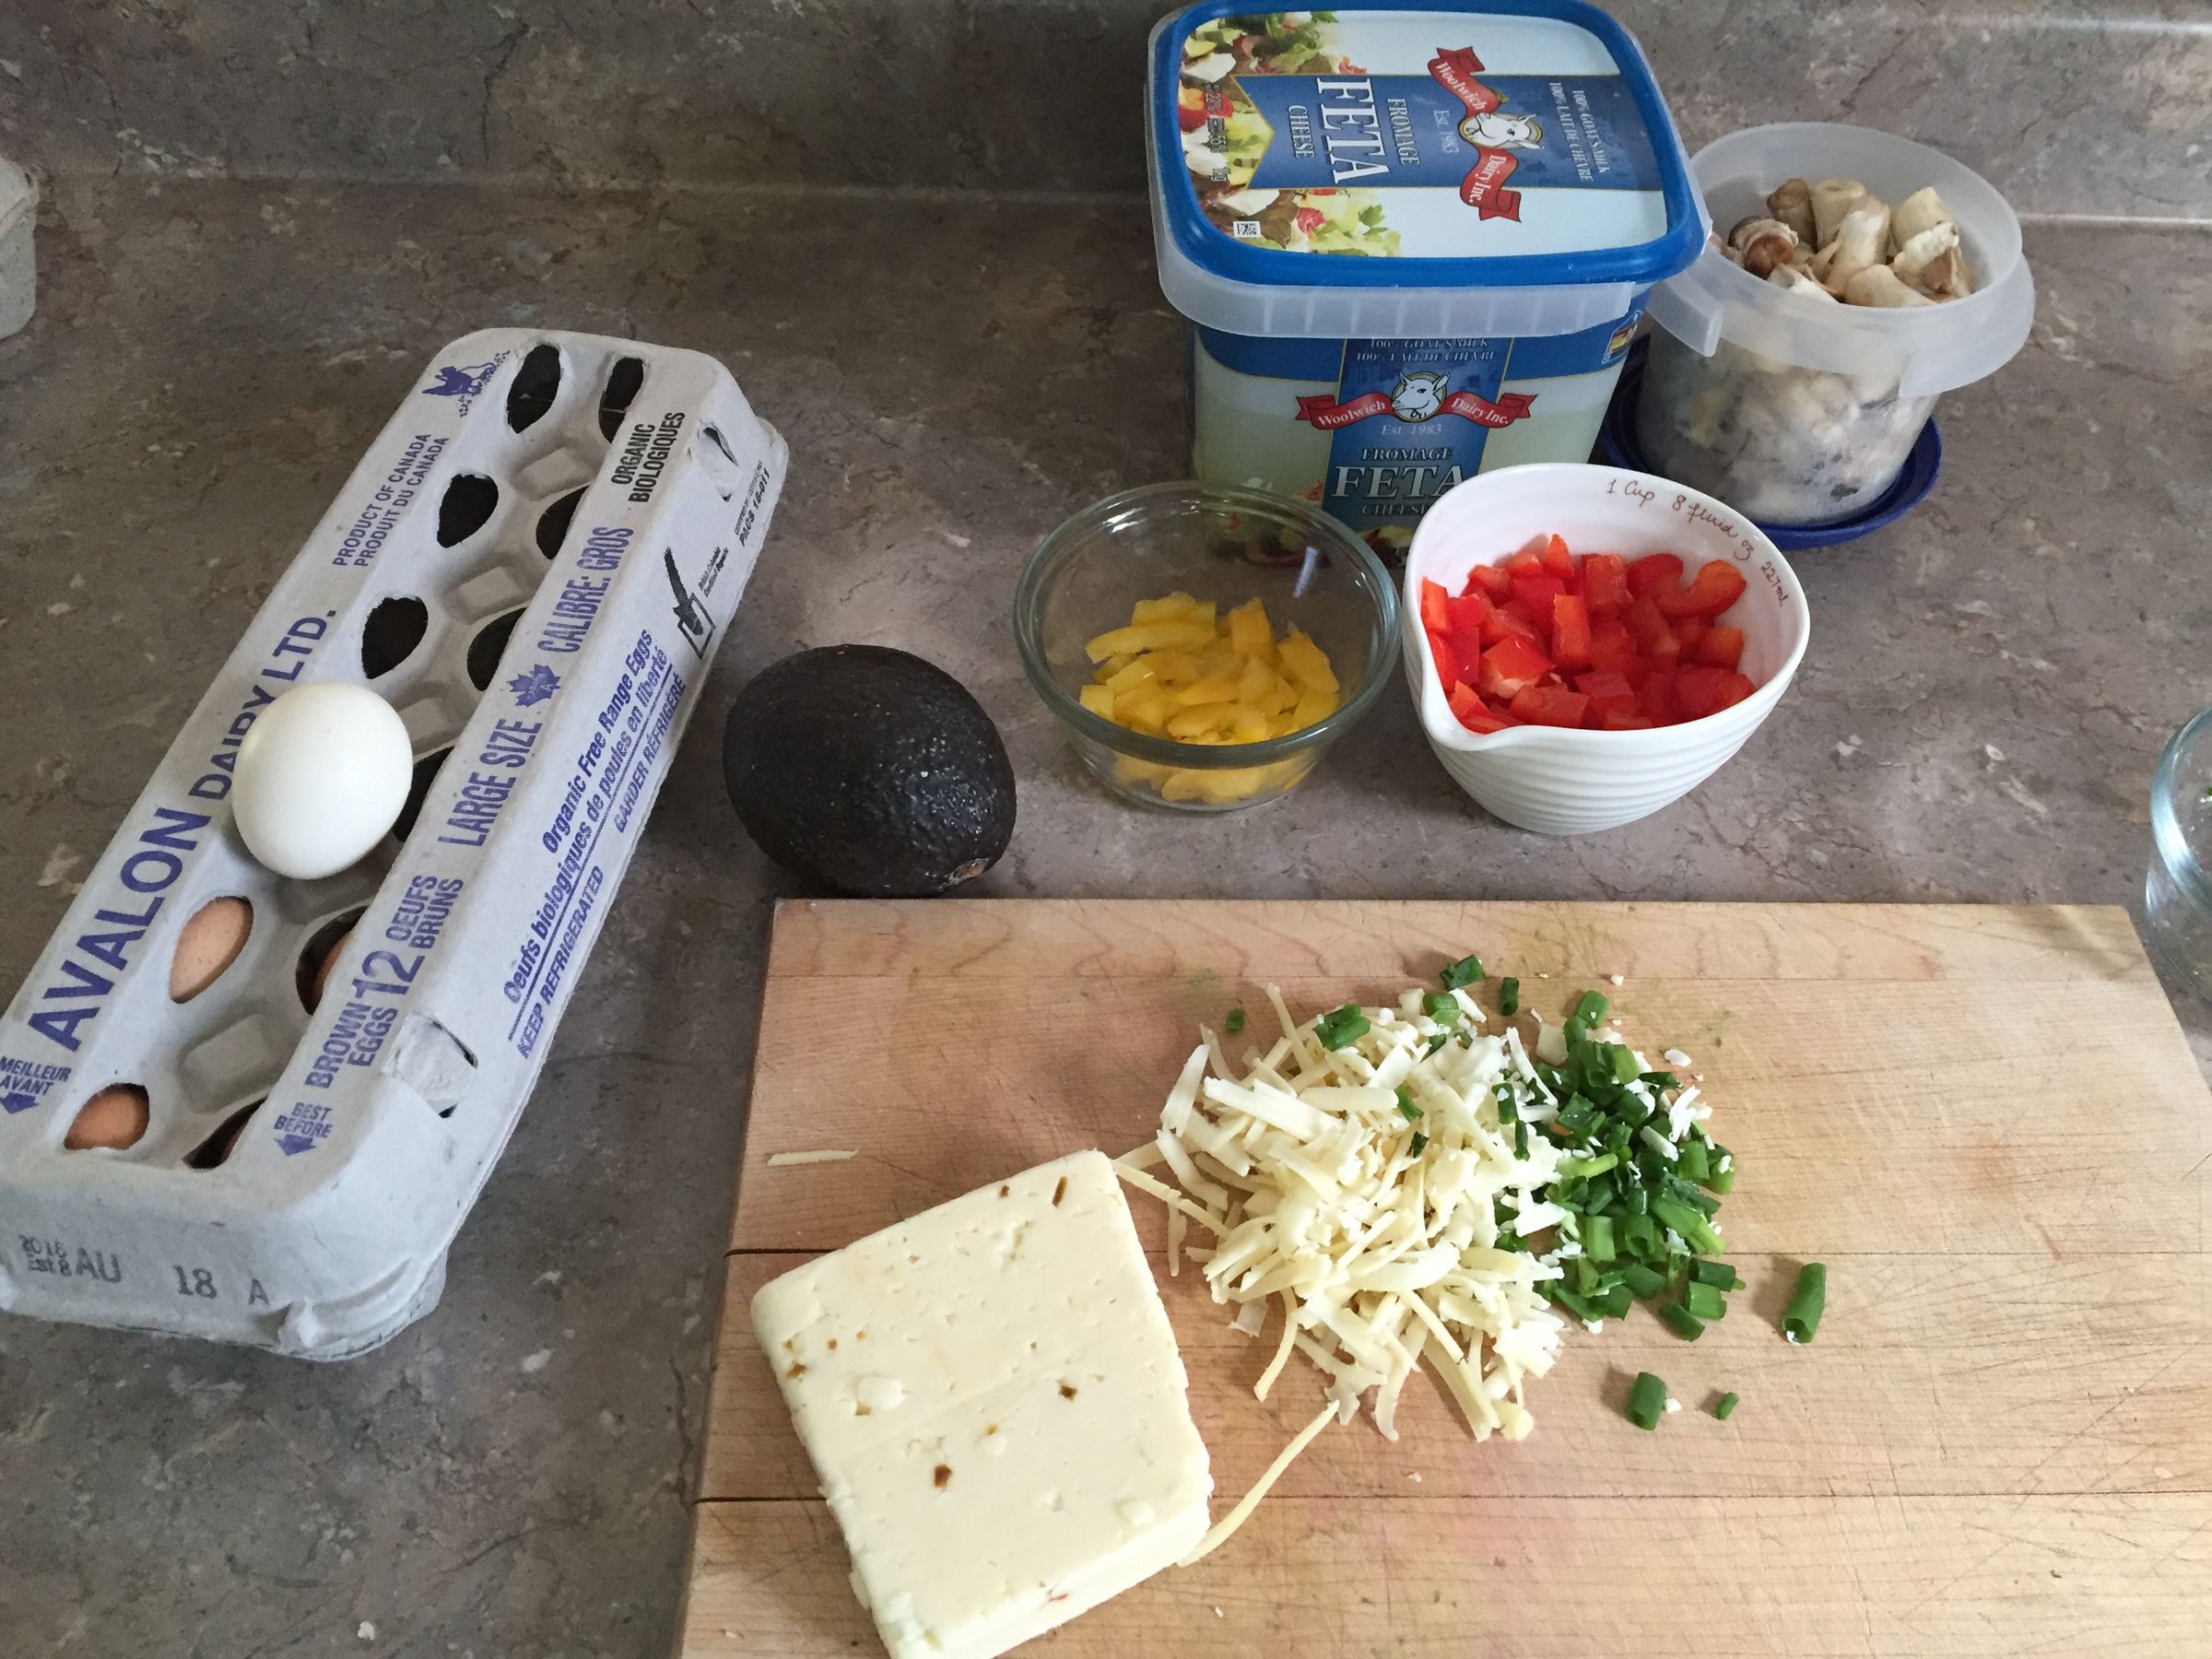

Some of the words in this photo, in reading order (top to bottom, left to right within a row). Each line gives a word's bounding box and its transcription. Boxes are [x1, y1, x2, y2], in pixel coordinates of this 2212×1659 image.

[1435, 62, 1488, 111] Woolwich
[1288, 104, 1315, 159] CHEESE
[1316, 77, 1390, 184] FETA
[1387, 98, 1420, 166] FROMAGE
[1439, 132, 1460, 154] 1983
[1468, 182, 1491, 204] Inc.
[1475, 155, 1507, 183] Dairy
[1318, 400, 1386, 427] Woolwich
[1451, 397, 1485, 418] Dairy
[1484, 409, 1509, 425] Inc.
[1410, 424, 1442, 435] 1983
[611, 423, 655, 484] ORGANIC
[628, 412, 686, 502] BIOLOGIQUES
[1331, 465, 1464, 498] FETA
[1361, 447, 1453, 460] FROMAGE
[332, 503, 382, 566] PRODUCT
[375, 485, 394, 501] OF
[387, 434, 431, 482] CANADA
[353, 510, 401, 567] PRODUIT
[393, 489, 414, 507] DU
[406, 438, 449, 486] CANADA
[1606, 478, 1617, 494] 1
[1624, 480, 1655, 507] Cup
[1672, 494, 1687, 511] 8
[1688, 502, 1738, 538] fluid
[1734, 539, 1755, 561] oz
[537, 576, 612, 653] CALIBRE:
[576, 526, 634, 571] GROS
[542, 774, 586, 853] Organic
[577, 731, 606, 777] Free
[598, 673, 633, 734] Range
[625, 629, 653, 677] Eggs
[438, 771, 516, 847] LARGE
[479, 718, 543, 768] SIZE
[614, 760, 650, 833] GARDER
[28, 806, 212, 1053] AVALON
[261, 609, 336, 682] LTD.
[504, 938, 541, 1004] Oeufs
[531, 821, 593, 941] biologiques
[586, 794, 605, 823] de
[599, 731, 632, 800] poules
[627, 706, 643, 734] en
[635, 645, 668, 707] liberté
[385, 876, 438, 941] OEUFS
[408, 878, 465, 949] BRUNS
[351, 950, 426, 999] 12
[517, 1002, 544, 1059] KEEP
[539, 865, 604, 1006] REFRIGERATED
[304, 1002, 372, 1088] BROWN
[347, 1007, 398, 1066] EGGS
[0, 1056, 72, 1082] MEILLEUR
[0, 1075, 54, 1095] AVANT
[273, 1114, 333, 1138] BEFORE
[291, 1102, 333, 1122] BEST
[75, 1246, 122, 1284] AU
[172, 1264, 218, 1300] 18
[248, 1277, 270, 1306] A
